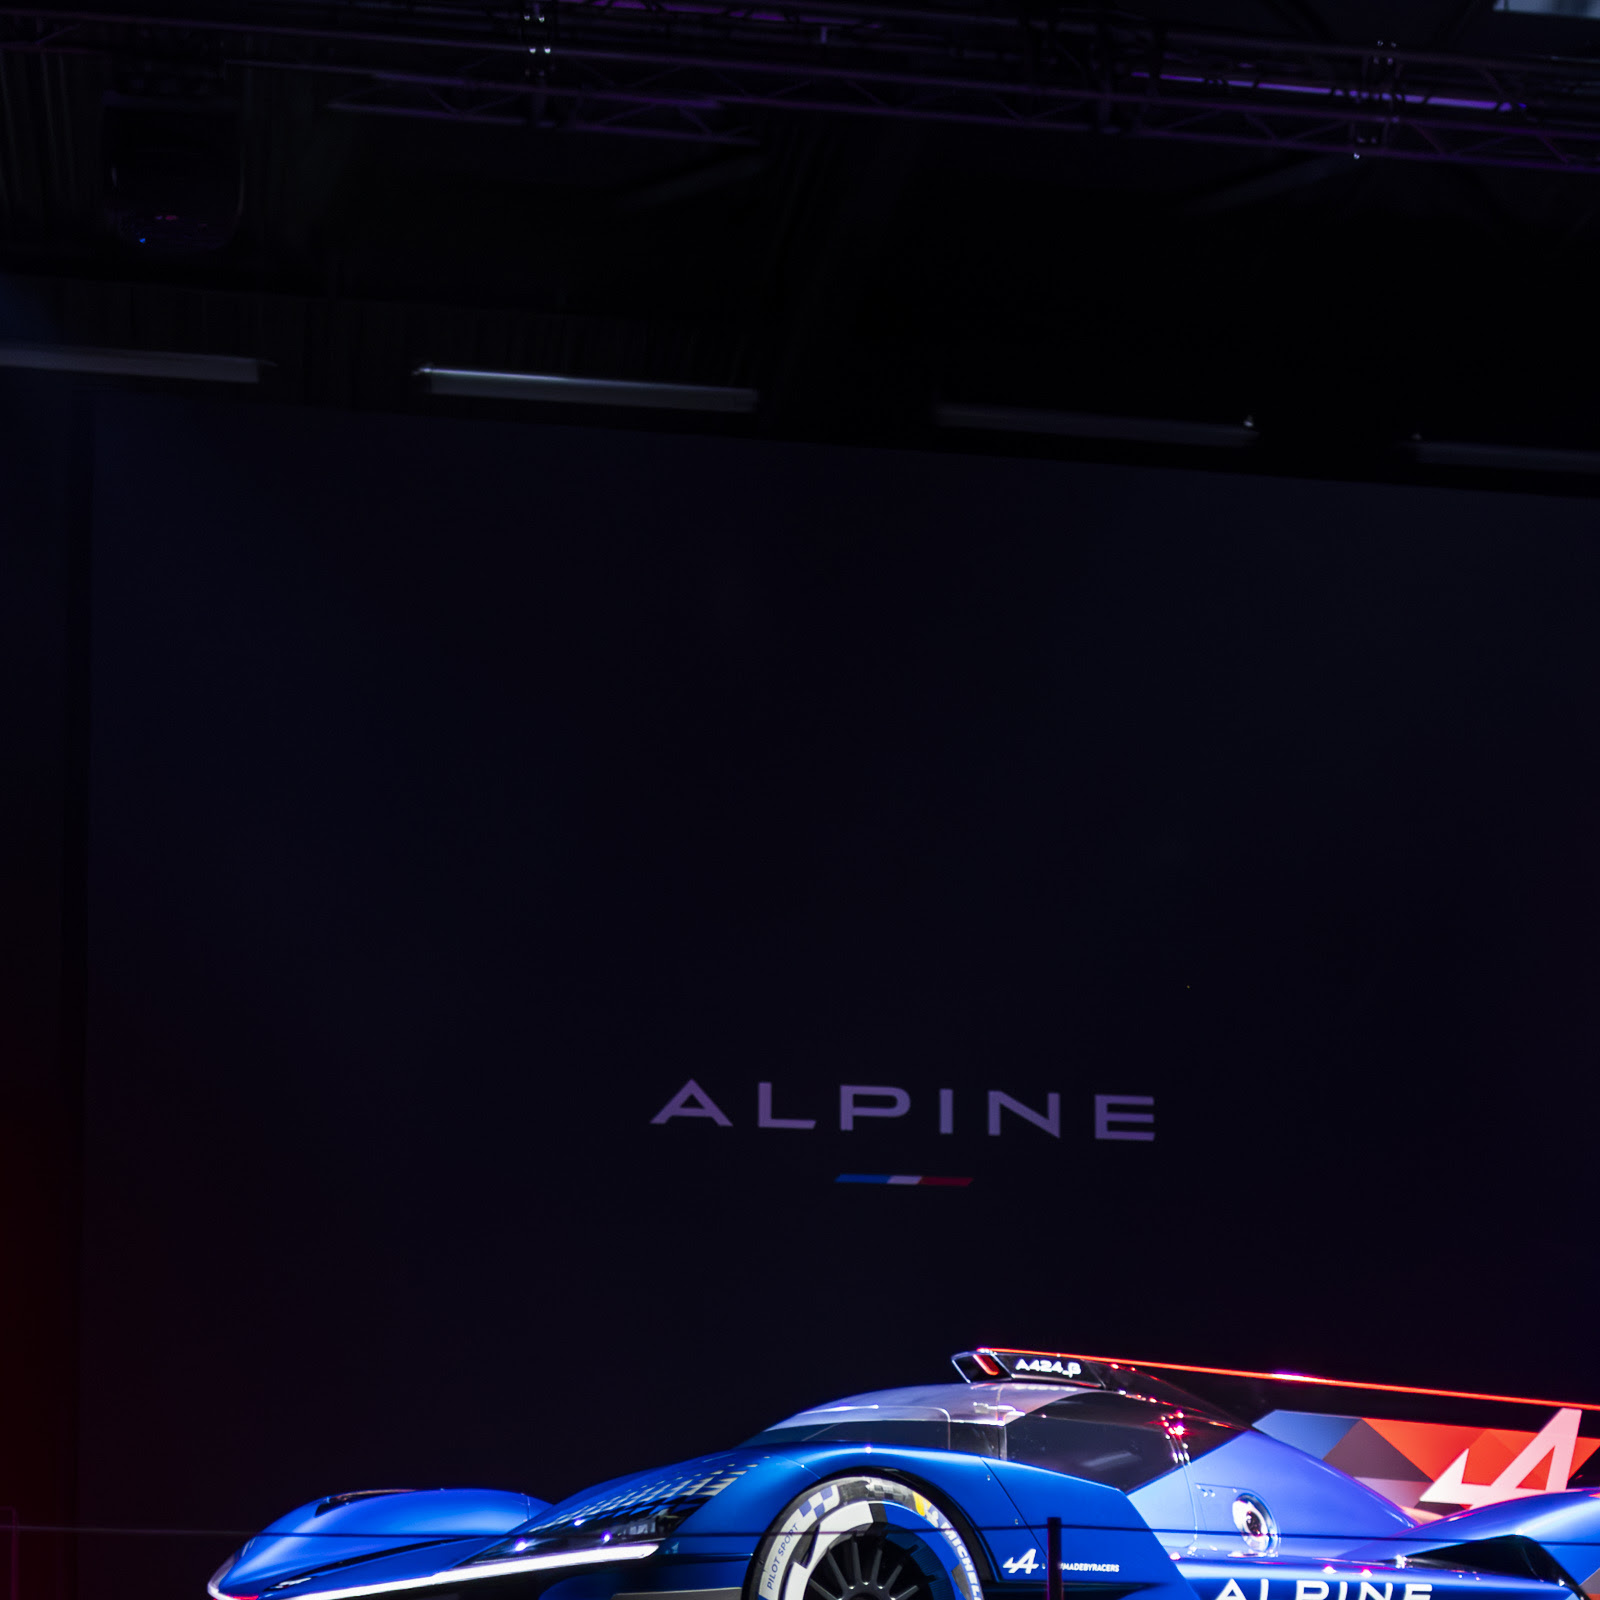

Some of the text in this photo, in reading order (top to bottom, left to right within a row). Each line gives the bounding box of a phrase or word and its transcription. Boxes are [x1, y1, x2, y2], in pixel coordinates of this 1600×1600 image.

[650, 1079, 1155, 1141] ALPINE
[766, 1523, 799, 1590] PILOT SPORT
